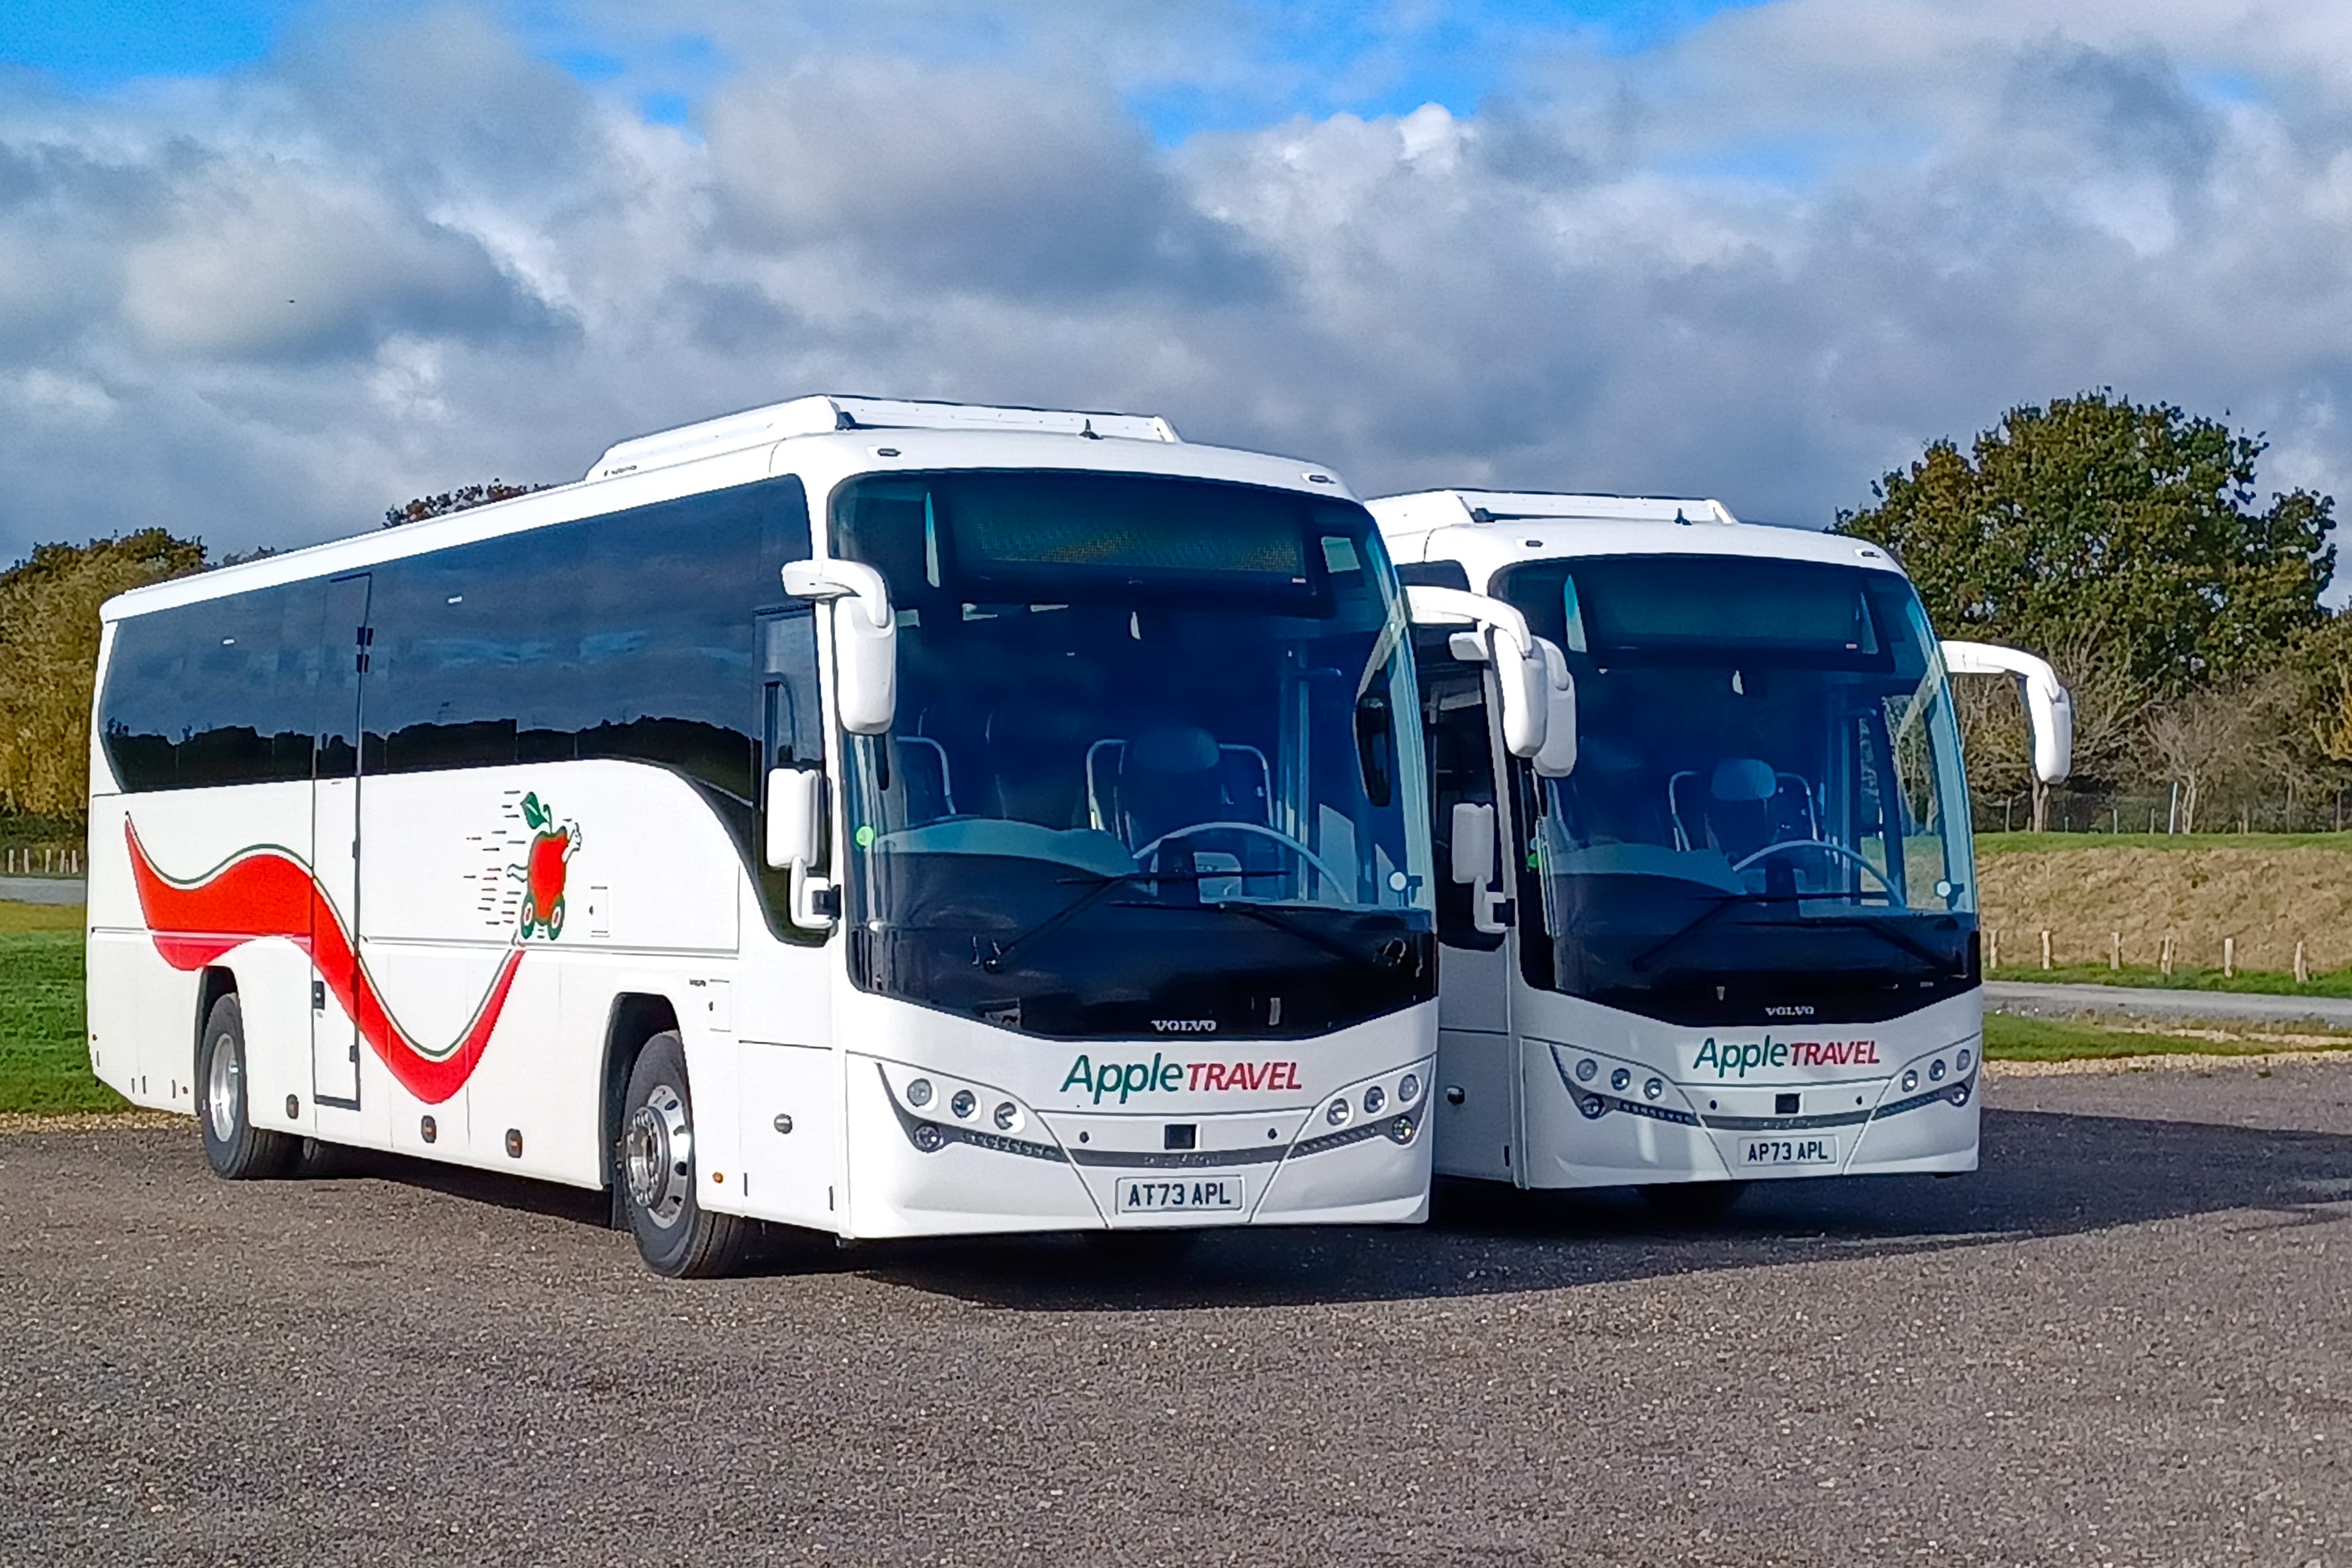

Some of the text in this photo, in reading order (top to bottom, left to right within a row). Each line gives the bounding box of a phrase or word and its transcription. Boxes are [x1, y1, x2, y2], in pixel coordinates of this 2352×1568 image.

[1765, 1006, 1814, 1016] VOLVO
[1151, 1020, 1216, 1031] VOLVO
[1747, 1141, 1828, 1162] AP73 APL
[1128, 1182, 1231, 1206] AT73 APL
